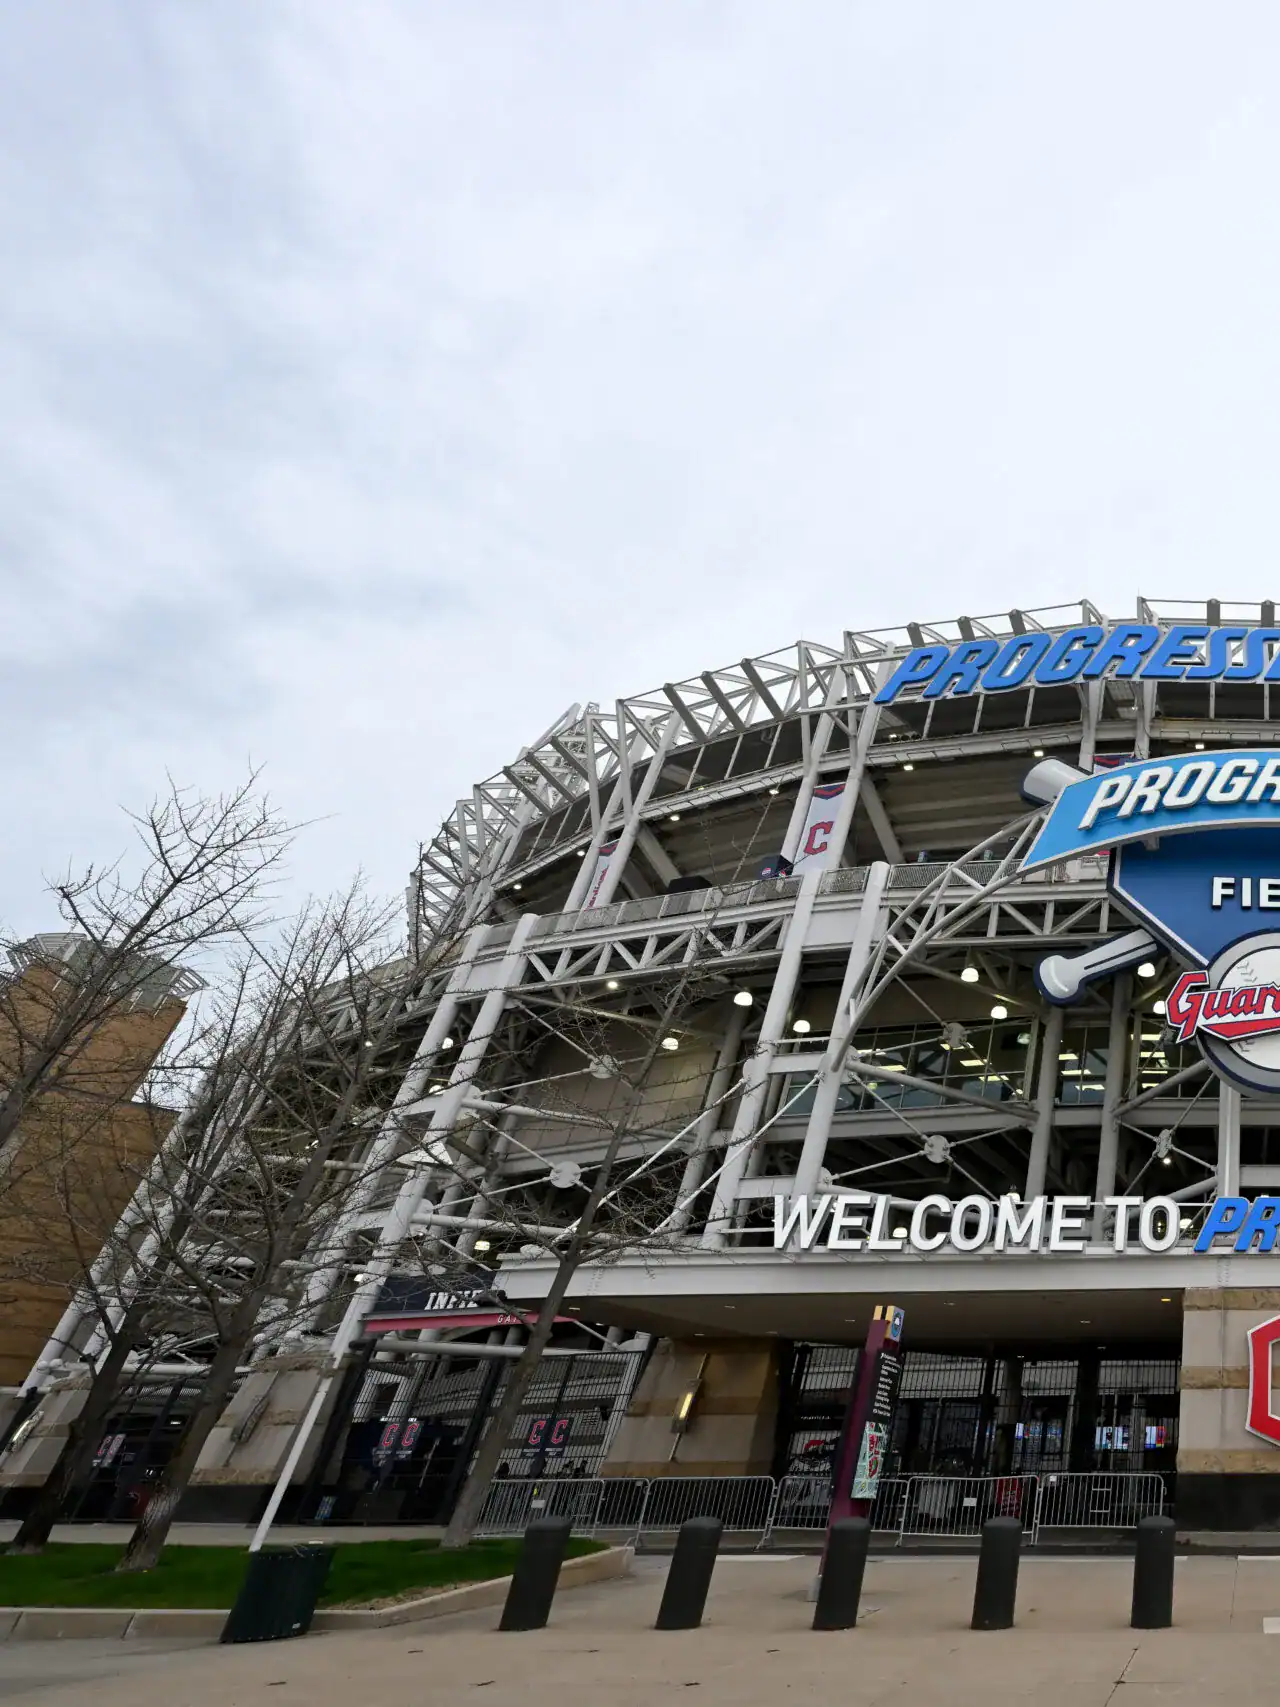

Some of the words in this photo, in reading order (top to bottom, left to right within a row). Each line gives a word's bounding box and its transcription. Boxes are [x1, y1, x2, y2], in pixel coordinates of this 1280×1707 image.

[804, 821, 834, 855] C
[773, 1194, 1090, 1252] WELCOME
[1103, 1196, 1180, 1252] TO
